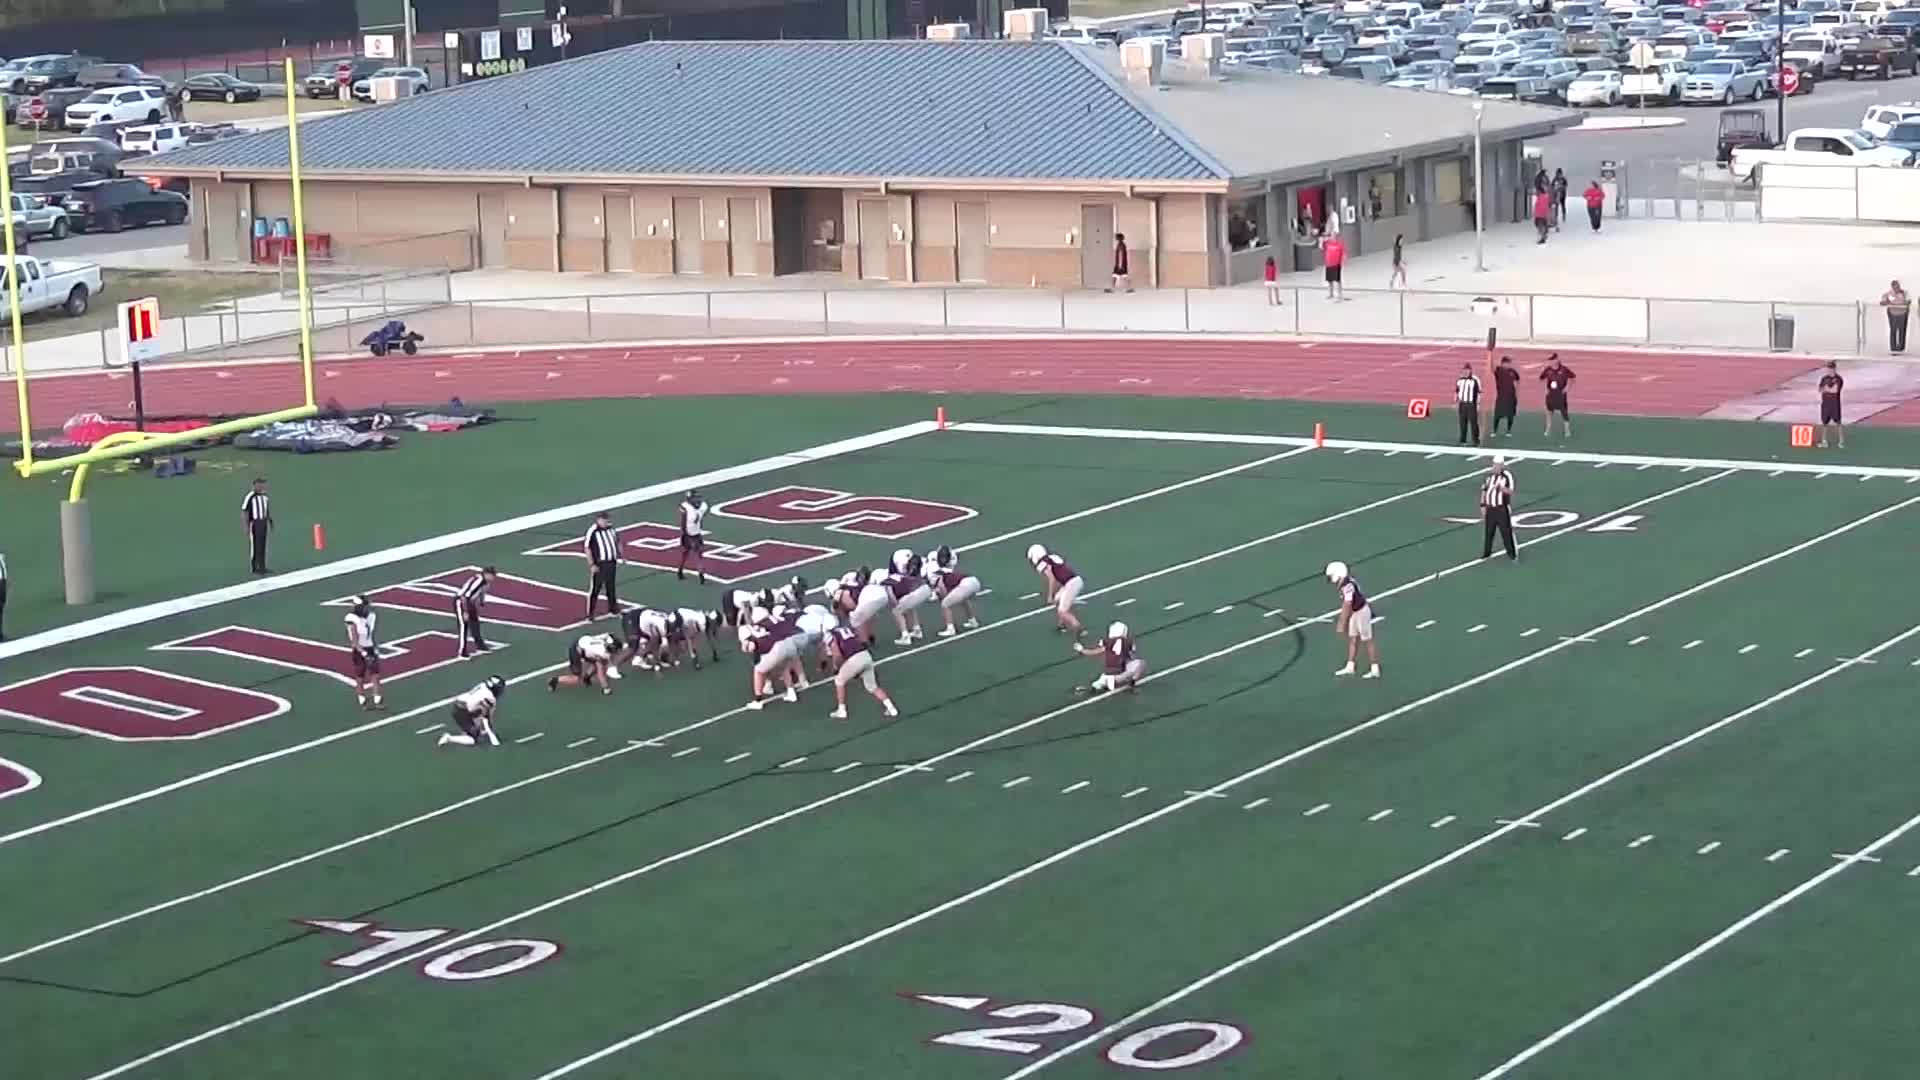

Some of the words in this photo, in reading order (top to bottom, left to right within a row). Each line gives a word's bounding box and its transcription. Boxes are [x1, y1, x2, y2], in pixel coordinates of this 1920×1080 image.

[1411, 400, 1425, 416] G
[1794, 426, 1810, 445] 10
[1111, 638, 1122, 656] 4
[326, 927, 561, 981] 10
[926, 1002, 1246, 1070] 20
